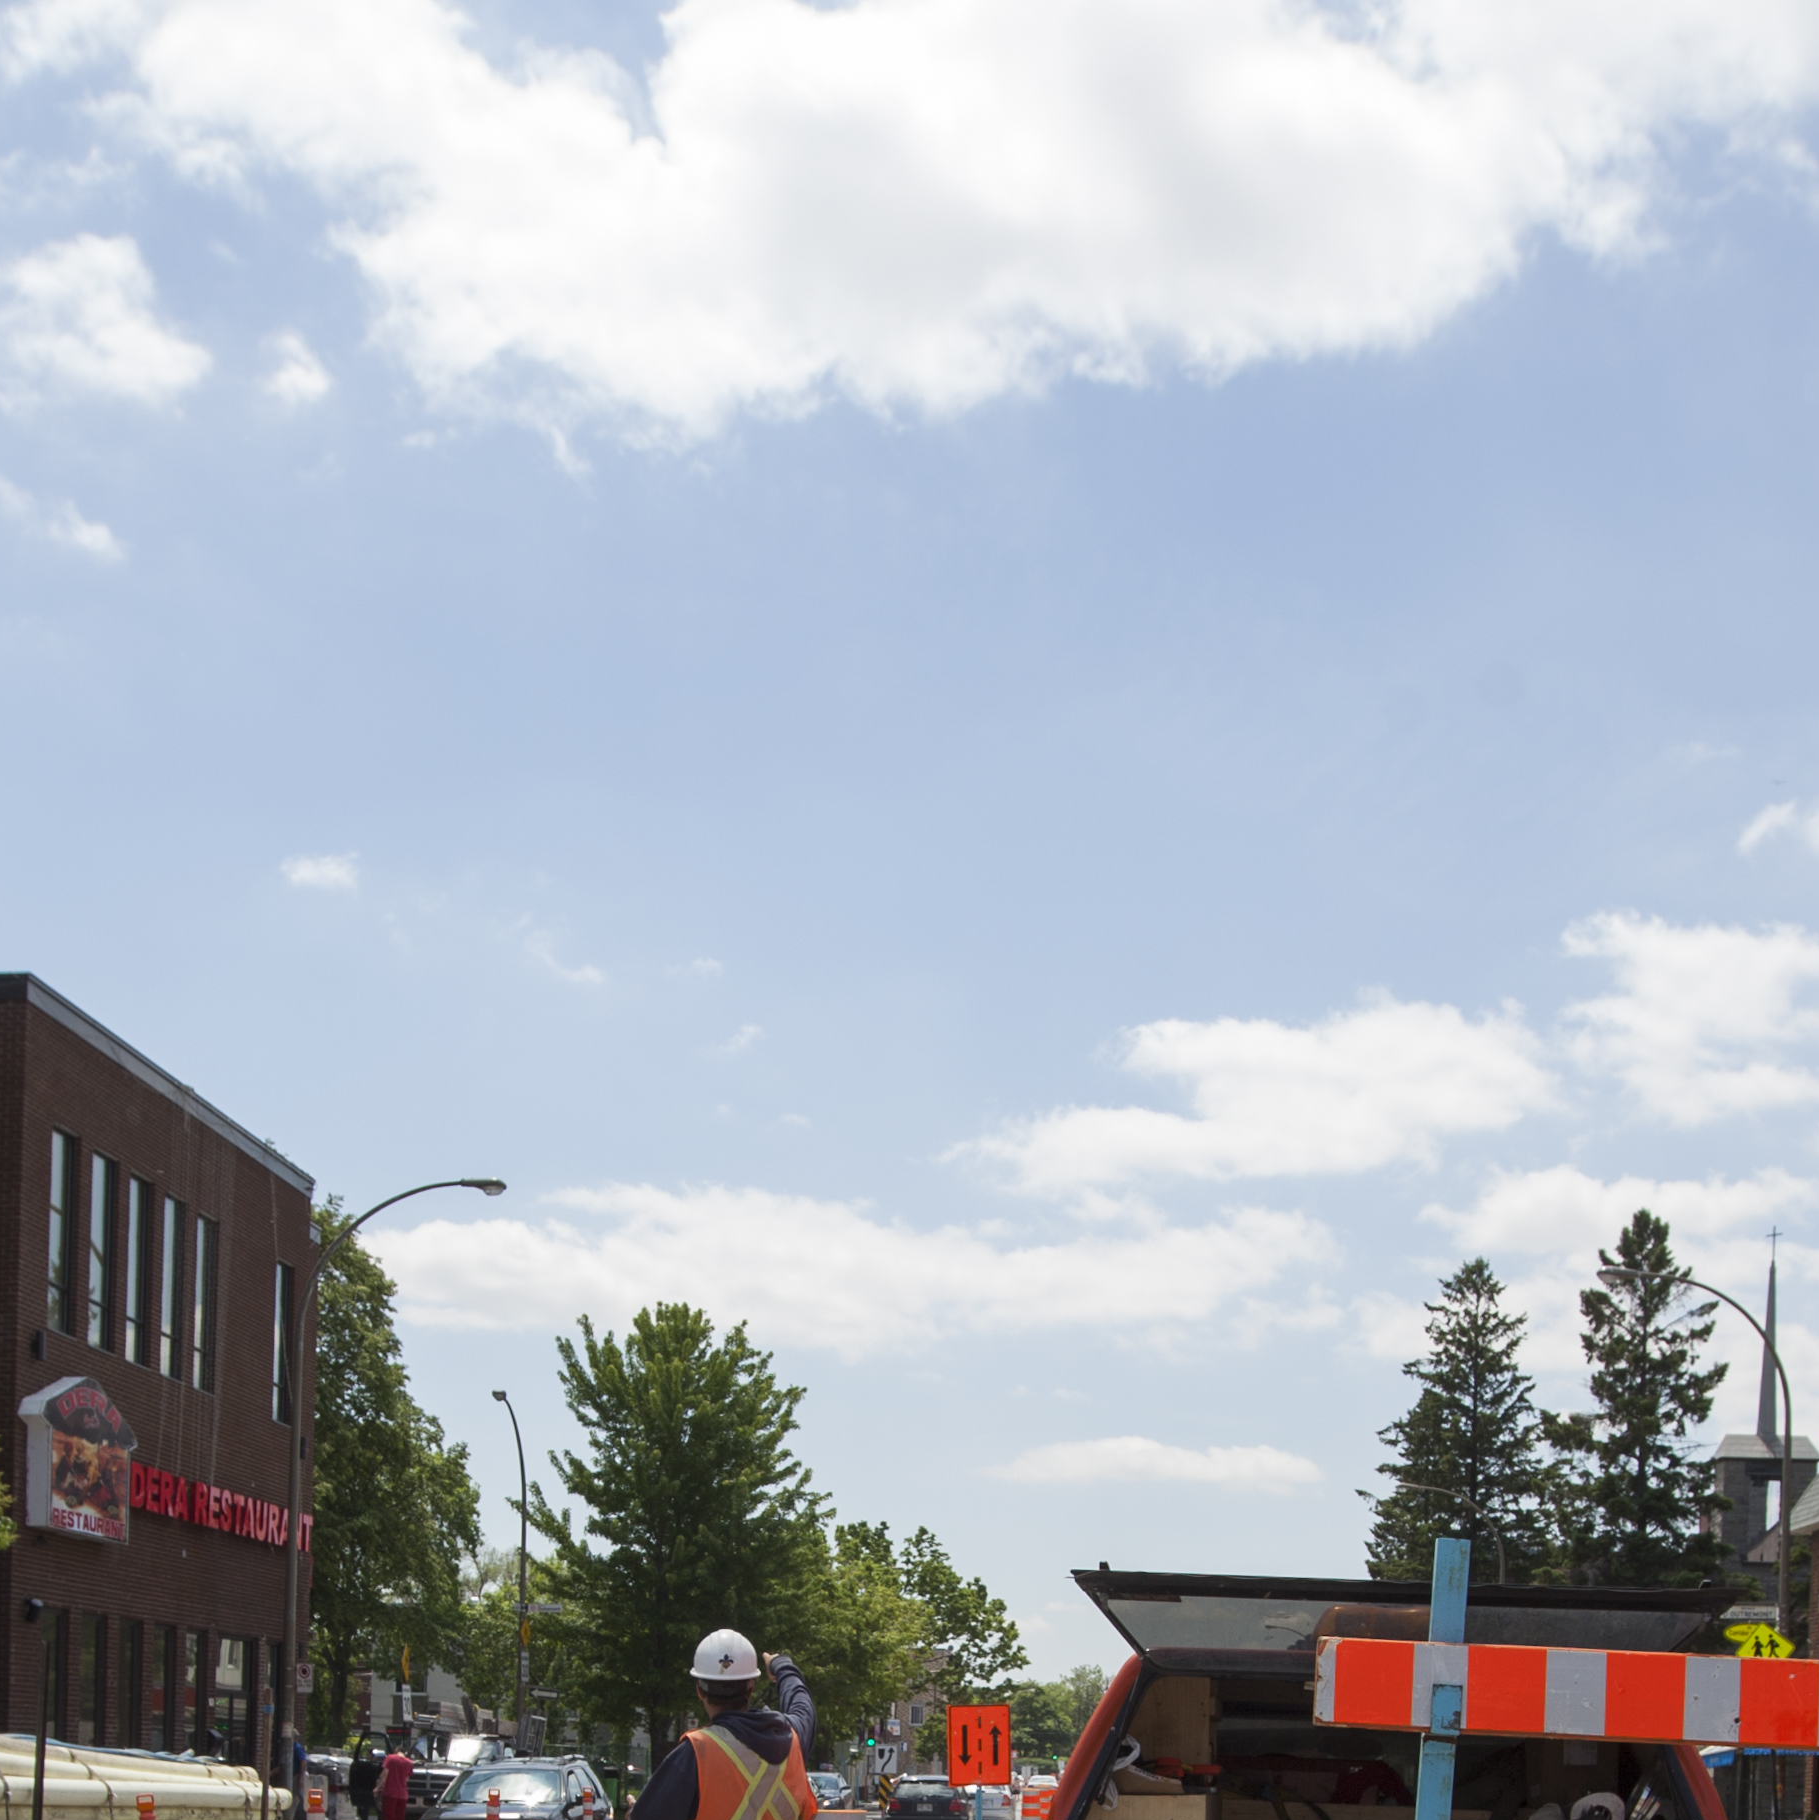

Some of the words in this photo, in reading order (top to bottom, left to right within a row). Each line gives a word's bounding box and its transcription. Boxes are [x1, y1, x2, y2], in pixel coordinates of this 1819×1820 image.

[56, 1387, 122, 1434] DERA
[131, 1461, 188, 1522] DERA
[52, 1507, 125, 1540] RESTAURANT
[1730, 1611, 1773, 1619] OUTREMONT
